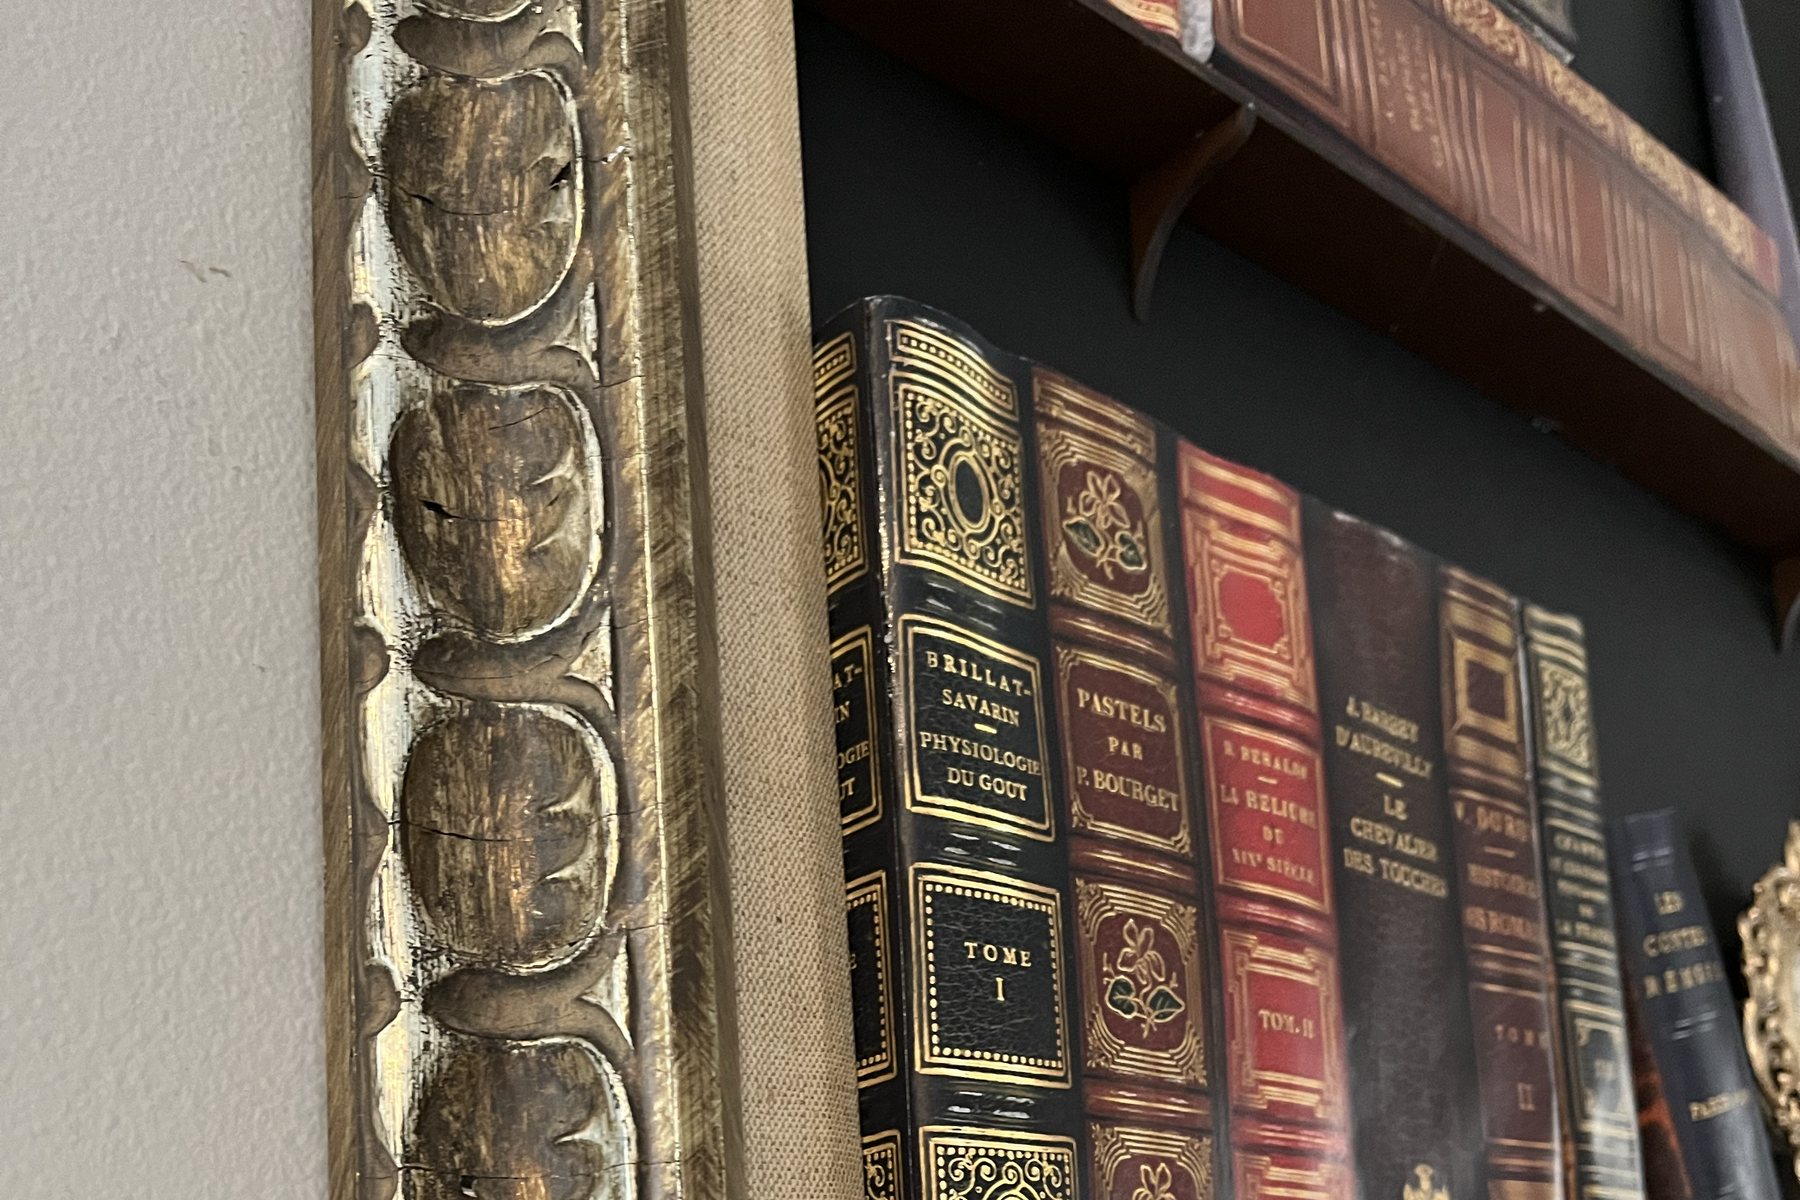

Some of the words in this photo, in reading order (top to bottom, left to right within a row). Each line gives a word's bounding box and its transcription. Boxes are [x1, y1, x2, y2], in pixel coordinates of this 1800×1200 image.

[925, 650, 1031, 698] BRILLAT-
[942, 688, 1020, 728] SAVARIN
[1076, 688, 1167, 734] PASTELS
[919, 731, 1041, 776] PHYSIOLOGIE
[1108, 735, 1143, 761] PAR
[947, 766, 975, 787] DU
[979, 772, 1028, 802] GOUT
[1093, 768, 1180, 812] BOURGET
[964, 941, 1032, 968] TOME
